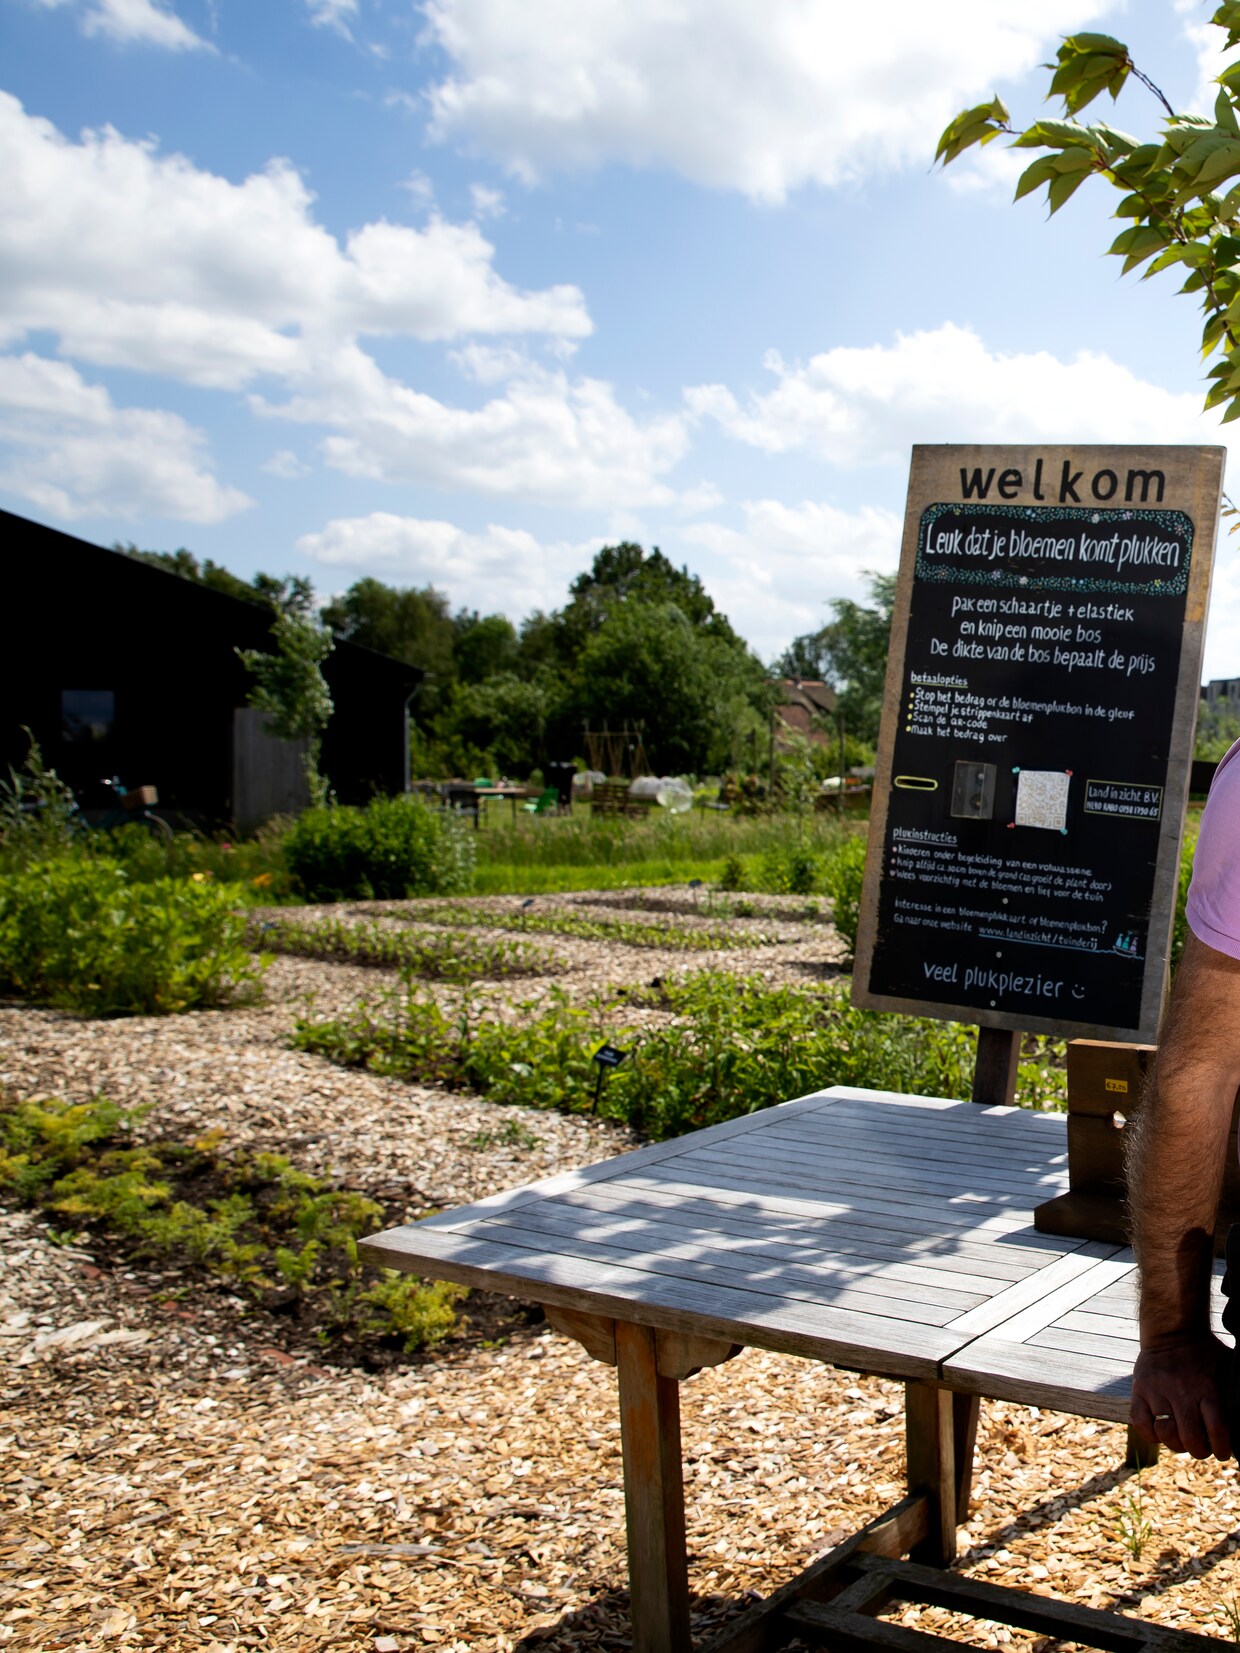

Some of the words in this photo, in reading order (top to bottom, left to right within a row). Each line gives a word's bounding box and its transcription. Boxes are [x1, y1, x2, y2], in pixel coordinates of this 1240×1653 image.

[960, 458, 1165, 502] welkom
[925, 523, 962, 556] Leuk
[965, 526, 991, 556] dat
[988, 530, 1006, 560] je
[1009, 530, 1075, 560] bloemen
[1079, 533, 1120, 563] komt
[1117, 534, 1180, 572] plukken
[976, 599, 997, 612] een
[1000, 597, 1062, 618] schaartje
[1077, 602, 1134, 622] elastiek
[960, 620, 975, 634] en
[978, 619, 1004, 640] knip
[1005, 624, 1027, 639] een
[1031, 625, 1072, 642] mooie
[1076, 624, 1102, 643] bos
[930, 638, 948, 656] De
[952, 638, 985, 659] dikte
[987, 646, 1008, 660] van
[1010, 643, 1025, 661] de
[1028, 644, 1050, 663] bos
[1053, 646, 1105, 672] bepaalt
[1108, 649, 1125, 670] de
[1127, 653, 1155, 677] prijs
[911, 670, 968, 688] betaalopties
[914, 700, 948, 716] Stempel
[951, 705, 959, 717] je
[961, 705, 1020, 721] strippenkaart
[1022, 713, 1033, 723] af
[916, 687, 935, 704] Stop
[937, 690, 951, 703] het
[955, 691, 984, 707] bedrag
[998, 696, 1010, 708] de
[1012, 696, 1082, 715] bloemenplukbon
[1085, 704, 1093, 716] in
[1094, 706, 1106, 717] de
[1108, 708, 1135, 722] gleuf
[913, 712, 934, 723] Scan
[936, 714, 946, 725] de
[937, 726, 950, 737] het
[954, 728, 984, 744] bedrag
[988, 734, 1007, 742] over
[893, 826, 957, 844] plukinstructies
[916, 860, 936, 871] altijd
[997, 870, 1018, 880] grond
[1031, 874, 1053, 885] groeit
[1054, 875, 1064, 885] de
[1065, 878, 1088, 889] plant
[934, 850, 955, 860] onder
[958, 852, 1002, 868] begeleiding
[1006, 860, 1020, 868] van
[1022, 861, 1037, 870] een
[1039, 863, 1092, 876] volwassene
[896, 869, 916, 880] Wees
[918, 874, 960, 888] voorzichtig
[962, 879, 976, 888] met
[979, 879, 988, 889] de
[991, 880, 1023, 892] bloemen
[1024, 886, 1035, 895] en
[1053, 889, 1071, 897] voor
[1072, 890, 1082, 900] de
[1084, 891, 1104, 902] tuin
[934, 903, 941, 913] in
[942, 907, 956, 915] een
[894, 913, 904, 924] Ga
[904, 917, 921, 925] naar
[922, 919, 938, 928] onze
[940, 920, 973, 932] website
[964, 966, 1064, 997] plukplezier
